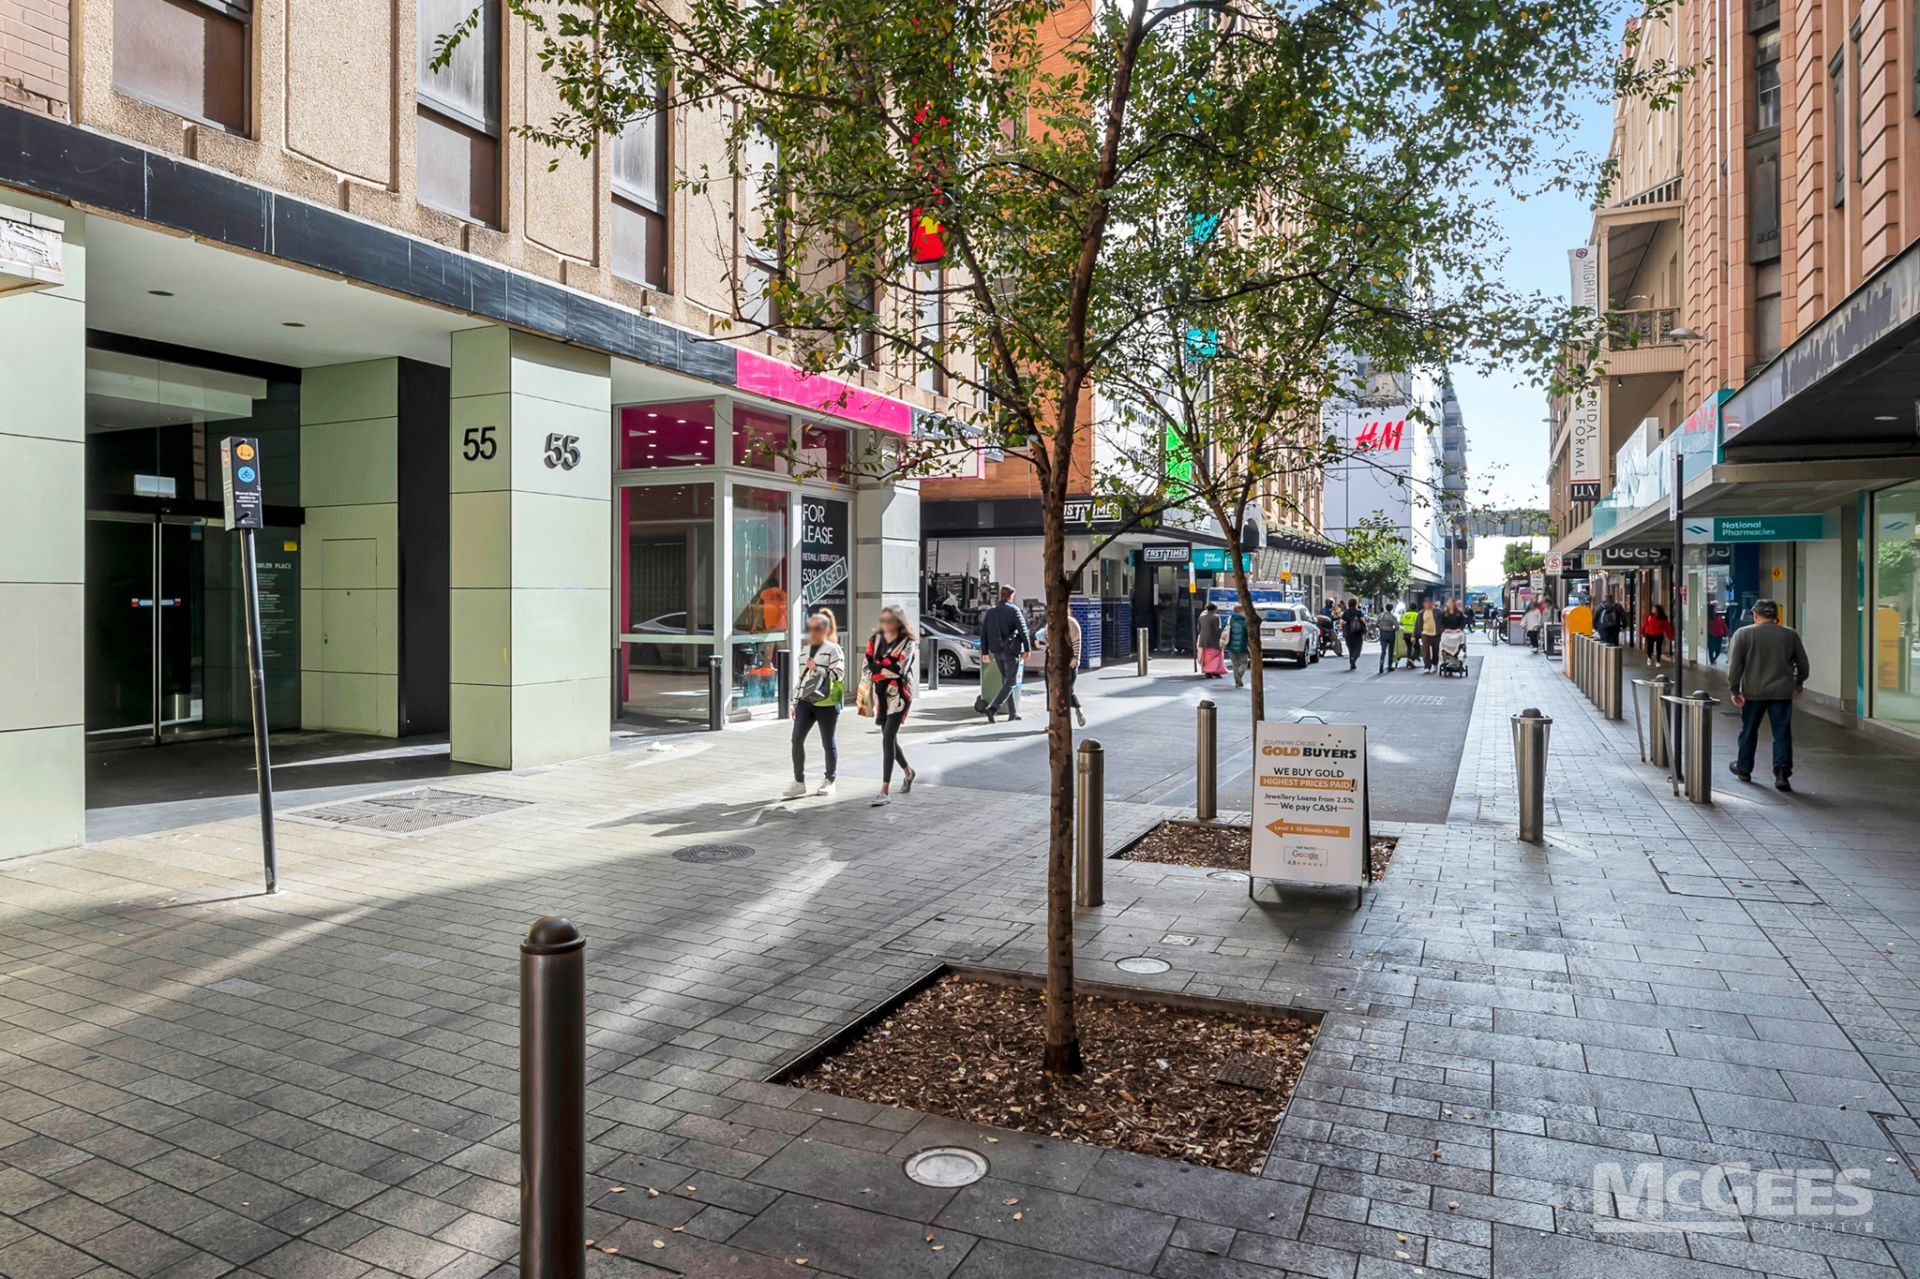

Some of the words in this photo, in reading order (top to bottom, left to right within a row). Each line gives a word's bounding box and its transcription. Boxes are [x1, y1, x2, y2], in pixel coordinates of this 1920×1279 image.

[463, 426, 497, 461] 55
[1575, 418, 1586, 476] FORMAL
[544, 432, 581, 471] 55
[1574, 484, 1598, 497] LUV
[802, 503, 825, 523] FOR
[1722, 521, 1761, 529] National
[802, 524, 833, 545] LEASE
[1722, 528, 1775, 536] Pharmacies
[1606, 547, 1661, 559] UGGS
[808, 563, 844, 601] LEASED
[1262, 746, 1301, 756] GOLD
[1302, 747, 1357, 759] BUYERS
[1274, 767, 1290, 776] WE
[1292, 768, 1313, 777] BUY
[1314, 769, 1345, 778] GOLD
[1263, 777, 1298, 786] HIGHEST
[1300, 779, 1329, 788] PRICES
[1264, 793, 1296, 802] Jewellery
[1280, 802, 1294, 810] We
[1295, 804, 1311, 812] pay
[1312, 804, 1338, 812] CASH
[1292, 850, 1319, 860] Google
